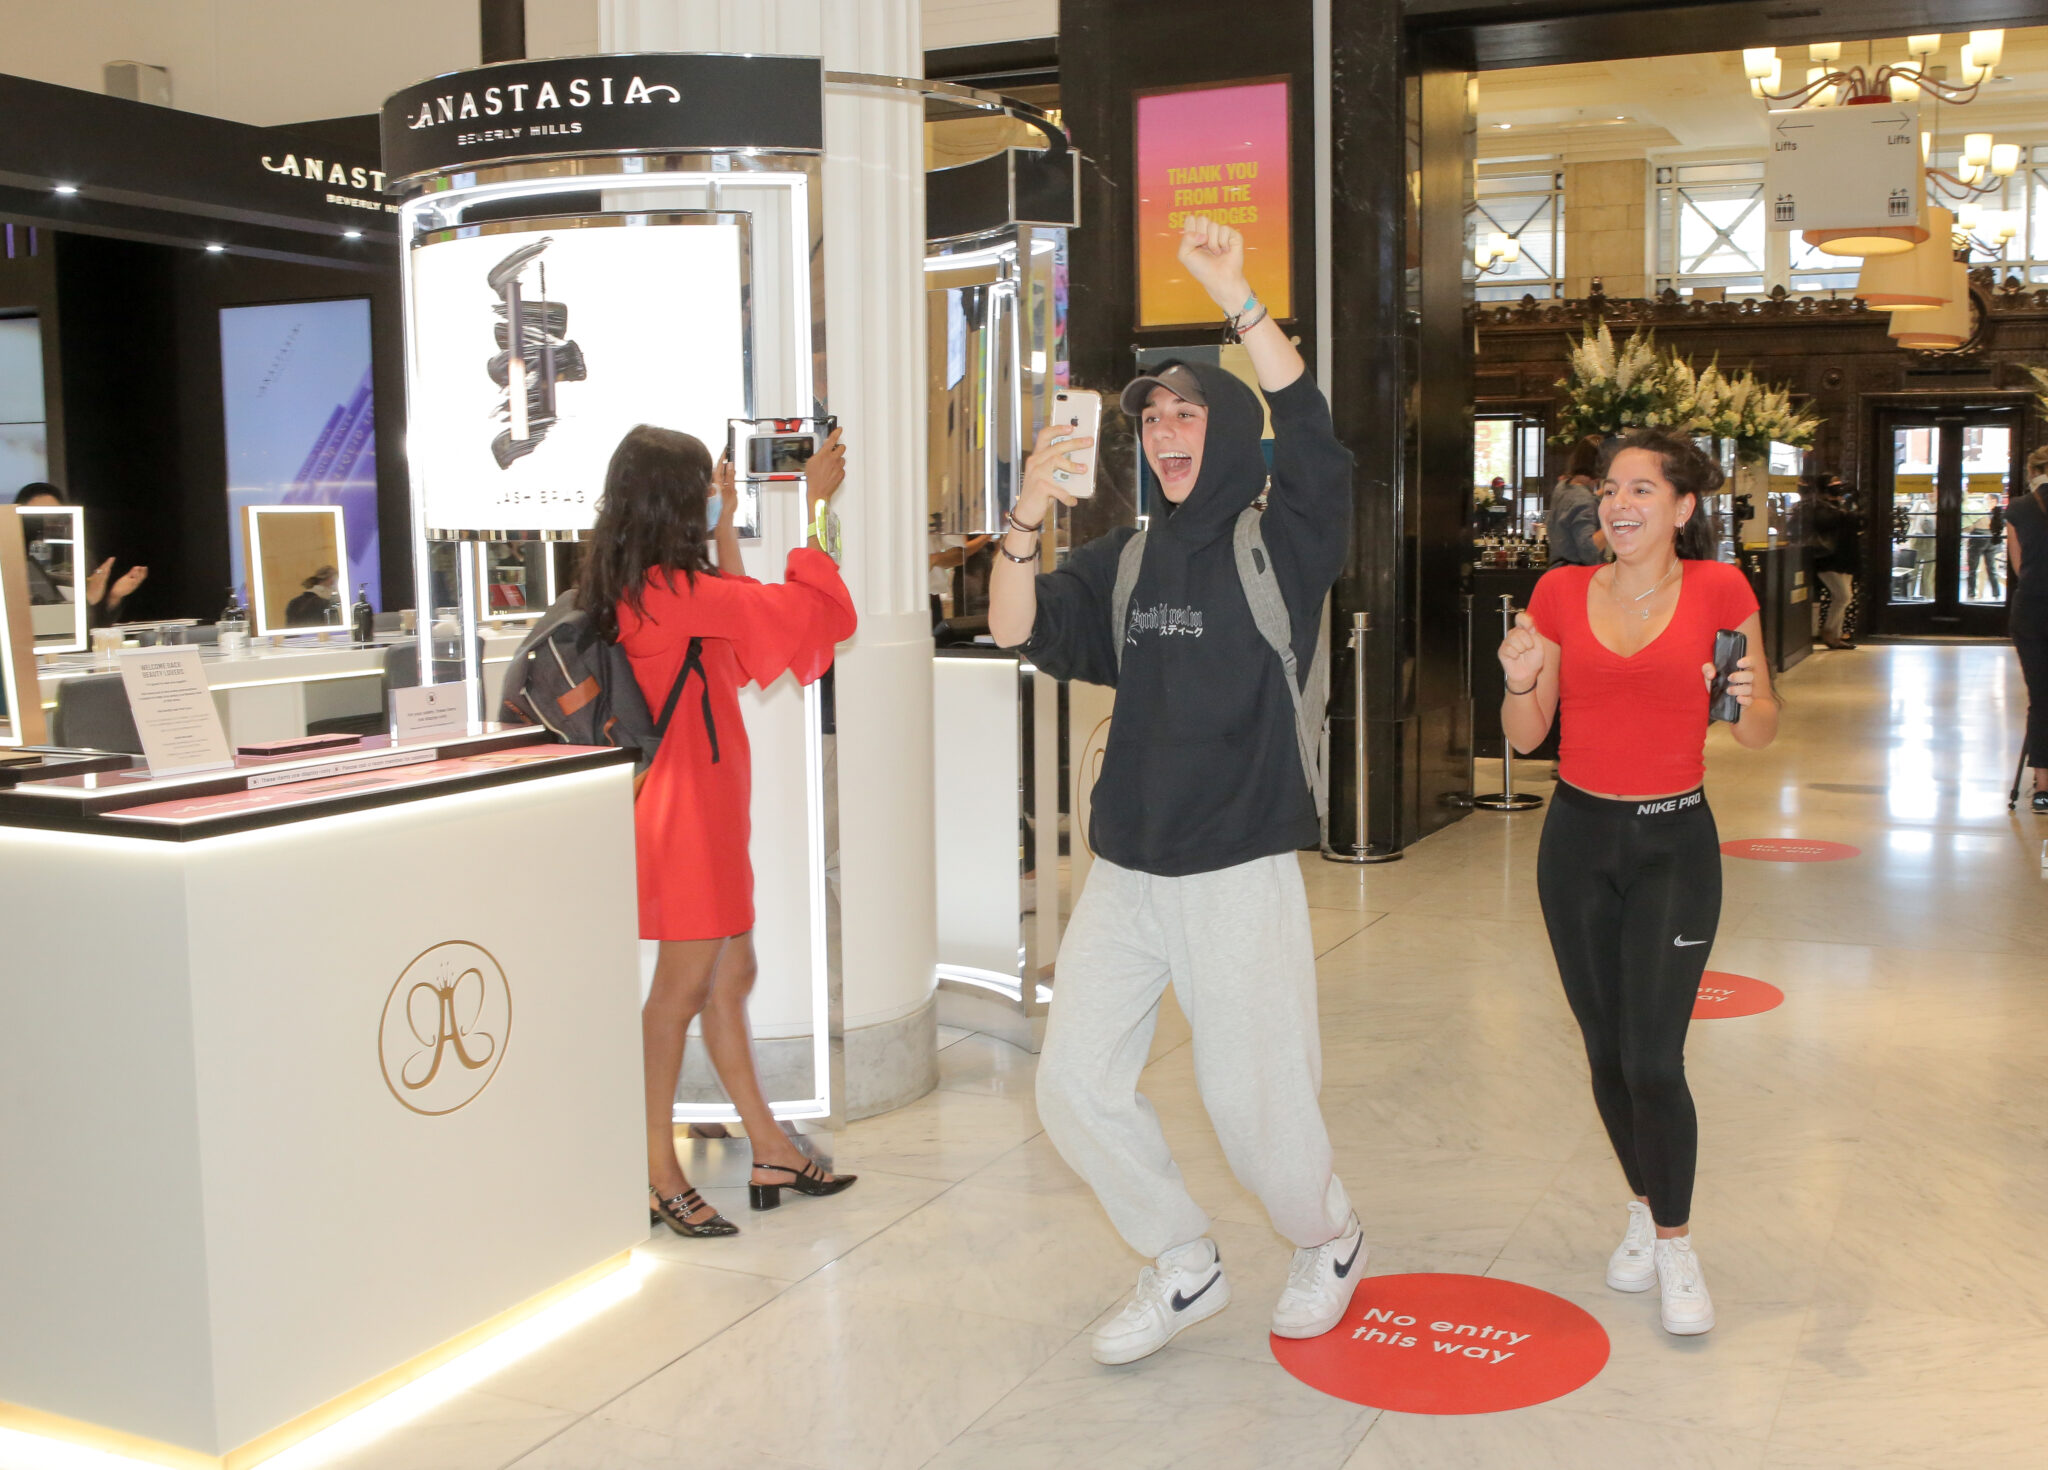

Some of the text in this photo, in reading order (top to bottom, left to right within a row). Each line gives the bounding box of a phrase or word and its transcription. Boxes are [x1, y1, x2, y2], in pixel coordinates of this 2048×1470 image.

[408, 76, 681, 130] ANASTASIA
[458, 122, 582, 146] BEVERLY HILLS
[1888, 134, 1911, 146] Lifts
[1775, 141, 1798, 152] Lifts
[261, 153, 387, 192] ANAST
[1167, 161, 1258, 186] THANK YOU
[1174, 184, 1252, 207] FROM THE
[1167, 205, 1259, 229] SEIDGES
[1637, 792, 1701, 815] NIKE PRO
[1697, 986, 1736, 997] try
[1697, 995, 1729, 1003] ay
[1363, 1307, 1532, 1346] No entry
[1351, 1325, 1516, 1365] this way
